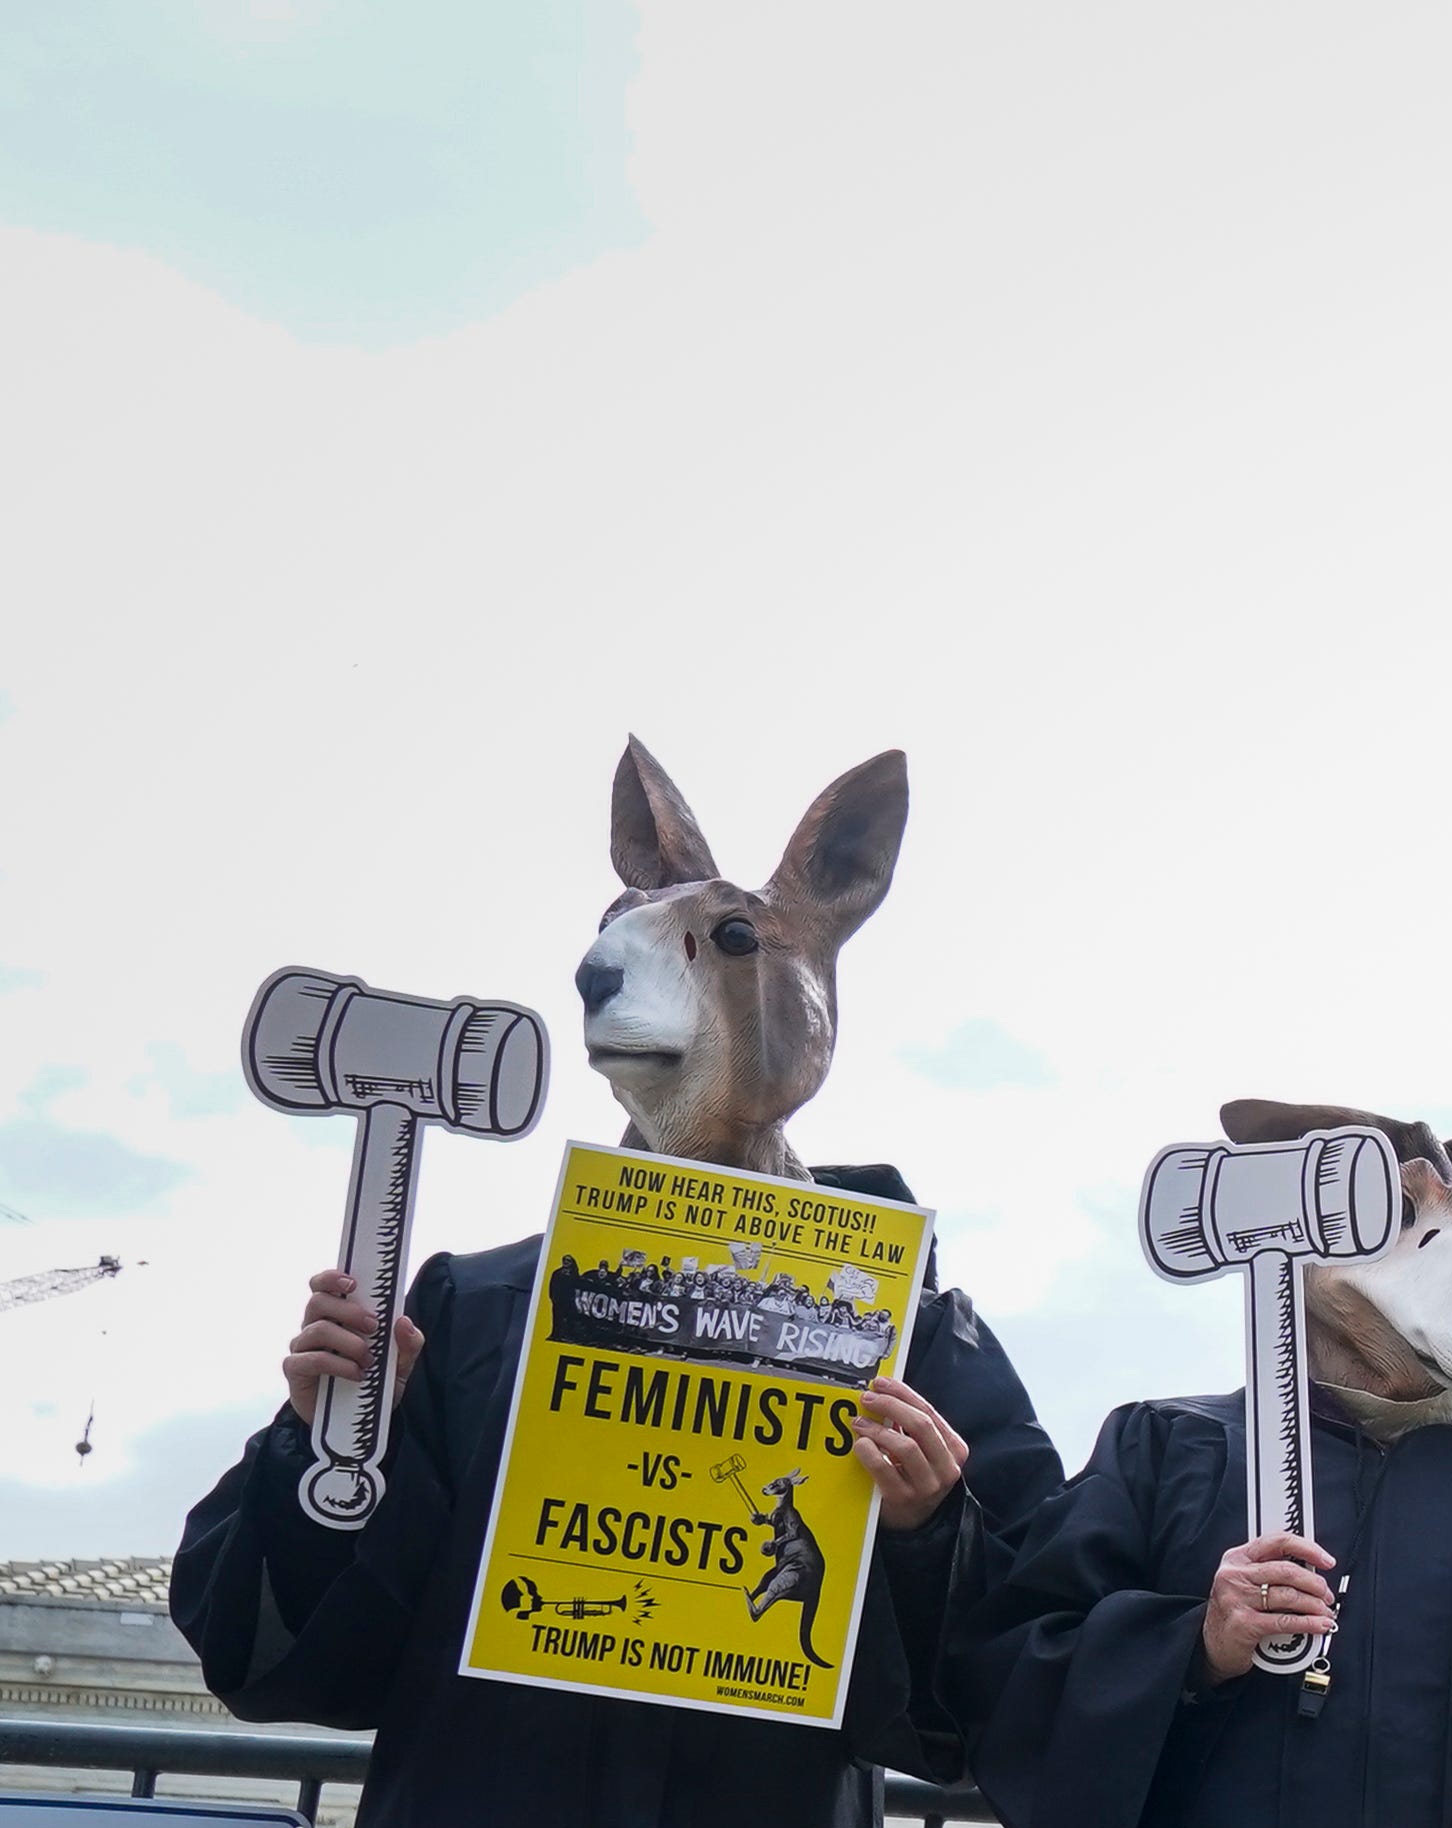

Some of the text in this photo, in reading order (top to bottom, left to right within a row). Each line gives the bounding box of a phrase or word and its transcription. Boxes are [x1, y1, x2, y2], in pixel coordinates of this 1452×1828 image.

[576, 1185, 904, 1264] TRUMP IS NOT ABOVE THE LAW
[619, 1166, 876, 1234] NOW HEAR THIS, SCOTUS!!
[575, 1289, 875, 1368] WOMEN'S WAVE RISING
[549, 1355, 858, 1457] FEMINISTS
[628, 1452, 692, 1490] -VS-
[536, 1498, 748, 1574] FASCISTS
[532, 1624, 810, 1691] TRUMP IS NOT IMMUNE!
[717, 1686, 804, 1706] WOMENSMARCH.COM
